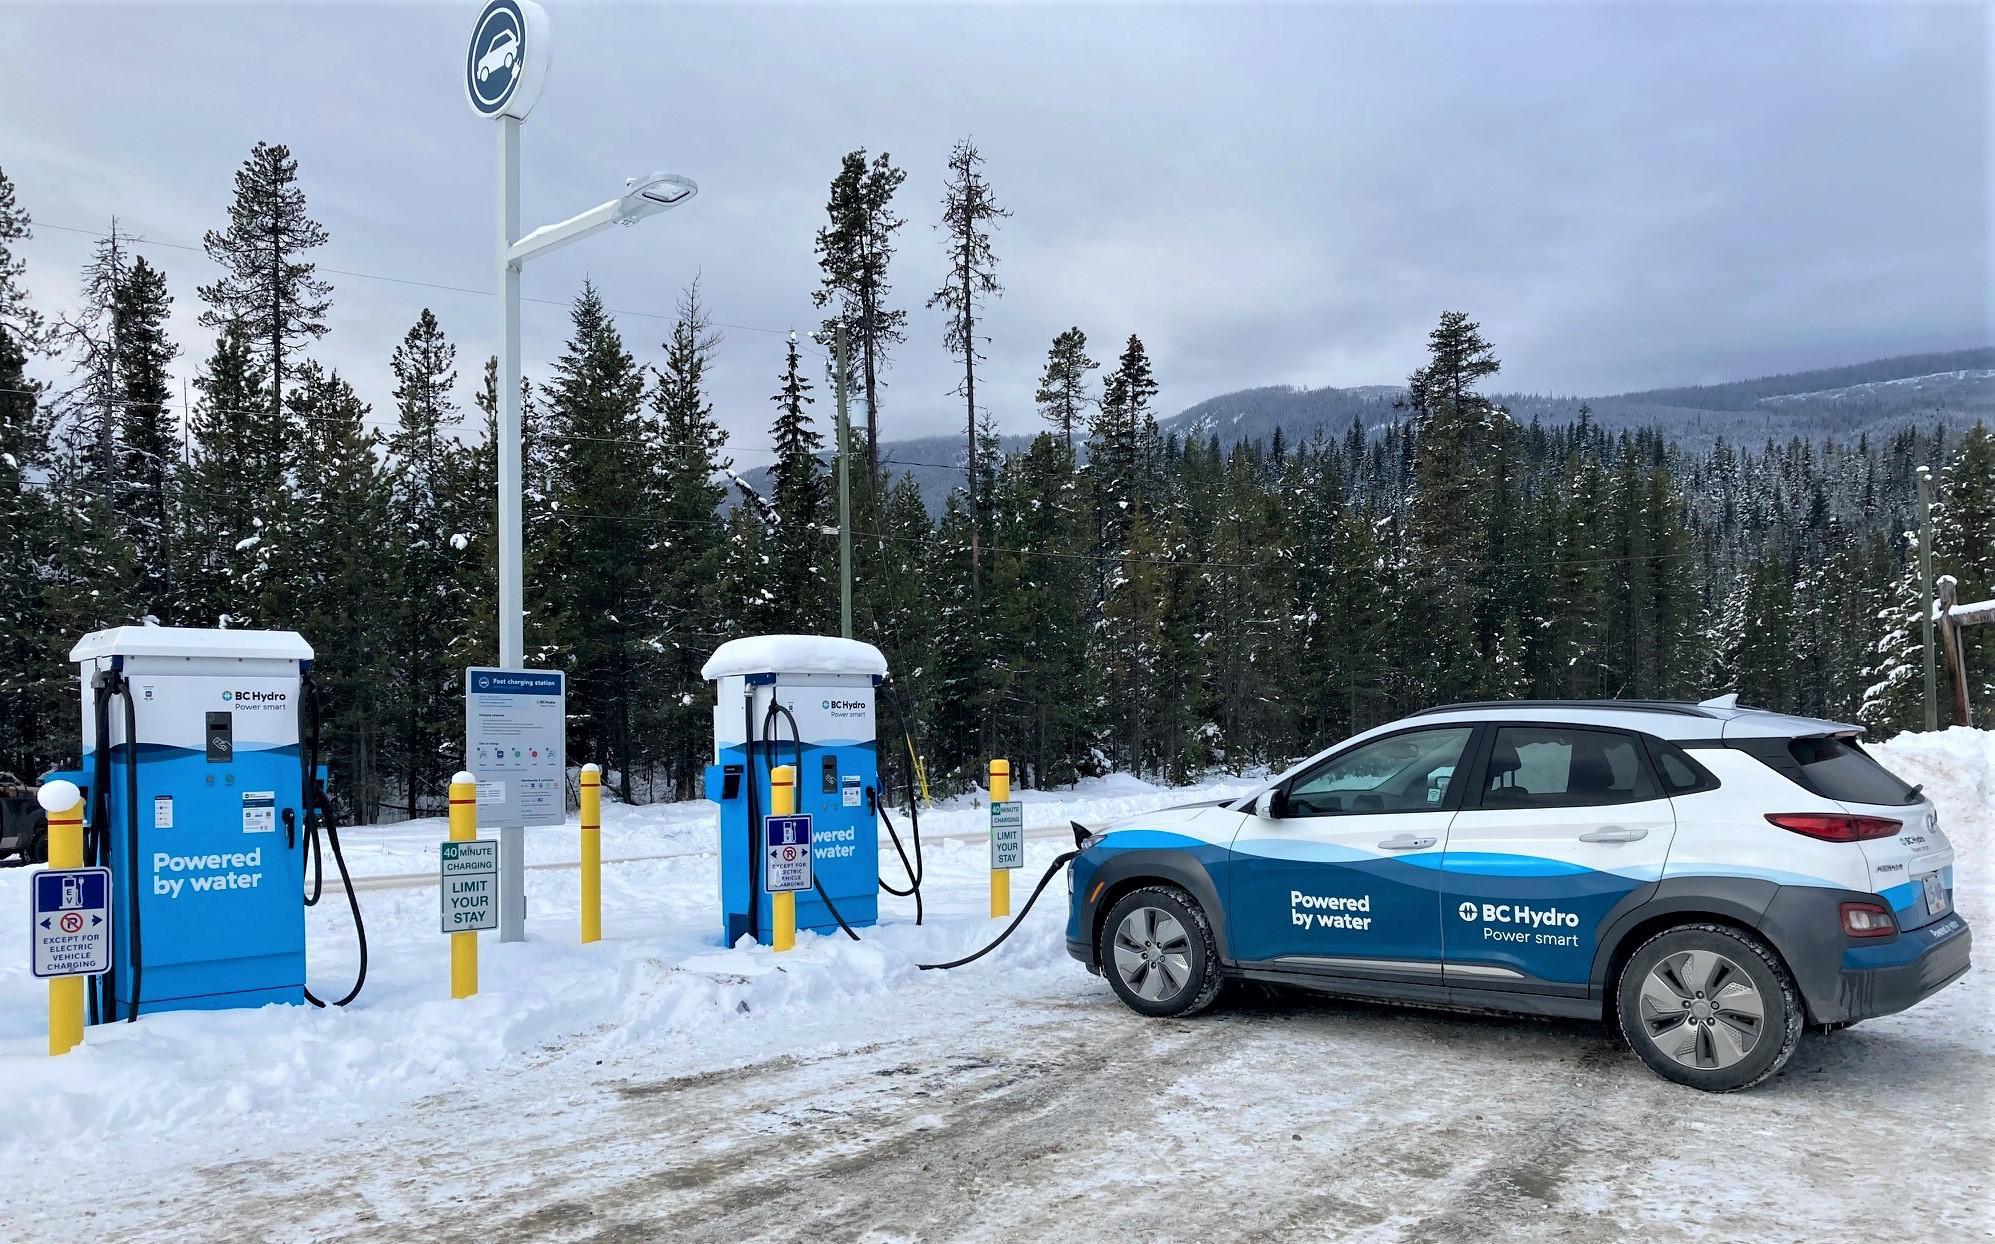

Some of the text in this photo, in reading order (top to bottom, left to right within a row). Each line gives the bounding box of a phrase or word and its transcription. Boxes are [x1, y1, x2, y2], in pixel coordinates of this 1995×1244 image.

[235, 691, 286, 702] BC Hydro
[235, 703, 286, 711] Power smart
[831, 700, 866, 711] BC Hydro
[812, 825, 855, 843] wered
[997, 831, 1017, 840] LIMIT
[443, 847, 492, 858] 40 MINUTE
[814, 844, 856, 859] water
[997, 842, 1018, 852] YOUR
[153, 847, 261, 873] Powered
[998, 854, 1017, 863] STAY
[447, 861, 493, 871] CHARGING
[153, 871, 262, 899] by water
[452, 880, 488, 894] LIMIT
[450, 895, 489, 909] YOUR
[1290, 890, 1370, 913] Powered
[453, 910, 487, 924] STAY
[1291, 909, 1372, 931] by water
[1482, 903, 1580, 929] BC Hydro
[43, 934, 100, 945] EXCEPT FOR
[1483, 927, 1580, 948] Power smart
[50, 943, 93, 953] ELECTRIC
[52, 952, 91, 961] VEHICLE
[47, 960, 97, 971] CHARGING
